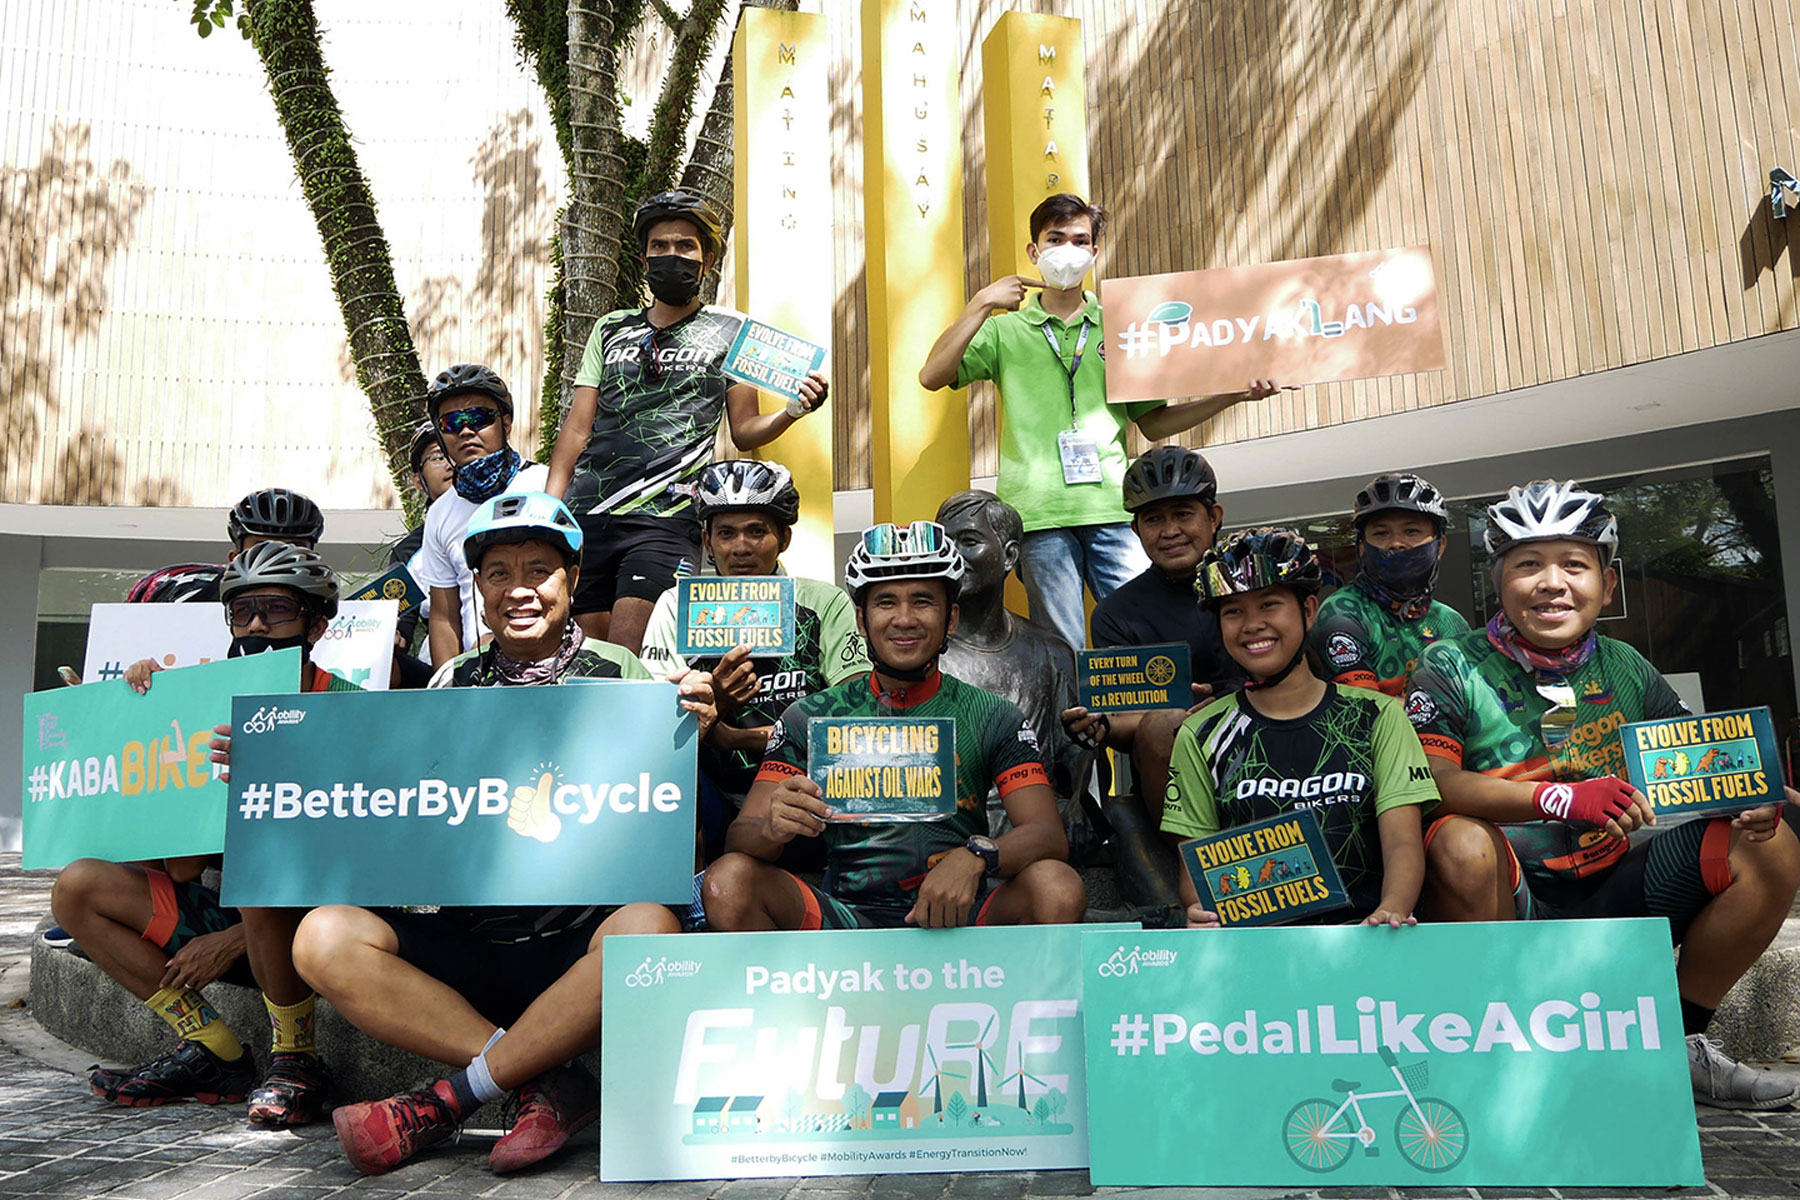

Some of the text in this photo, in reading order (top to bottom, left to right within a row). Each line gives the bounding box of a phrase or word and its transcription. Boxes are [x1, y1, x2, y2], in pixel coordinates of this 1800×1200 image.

[747, 322, 788, 352] EVOLVE
[731, 354, 801, 396] FOSSIL FUELS
[689, 582, 781, 601] EVOLVE FROM
[687, 627, 783, 648] FOSSIL FUELS
[1088, 655, 1138, 669] EVERY TURN
[1089, 672, 1146, 687] OF THE WHEEL
[1091, 689, 1168, 707] IS A REVOLUTION
[827, 725, 939, 755] BICYCLING
[1635, 713, 1754, 751] EVOLVE FROM
[826, 765, 942, 799] AGAINST OIL WARS
[1010, 768, 1028, 781] reg
[1237, 772, 1365, 800] DRAGON
[1294, 794, 1360, 810] BIKERS
[1646, 771, 1769, 809] FOSSIL FUELS
[1195, 820, 1305, 869] EVOLVE FROM
[1215, 876, 1330, 925] FOSSIL FUELS
[745, 959, 1005, 1000] Padyak to the
[1110, 992, 1661, 1056] #PedalLikeAGirl
[731, 1147, 1028, 1164] #BetterbyBicycle #MobilityAwards #EnergyTransitionNow!
